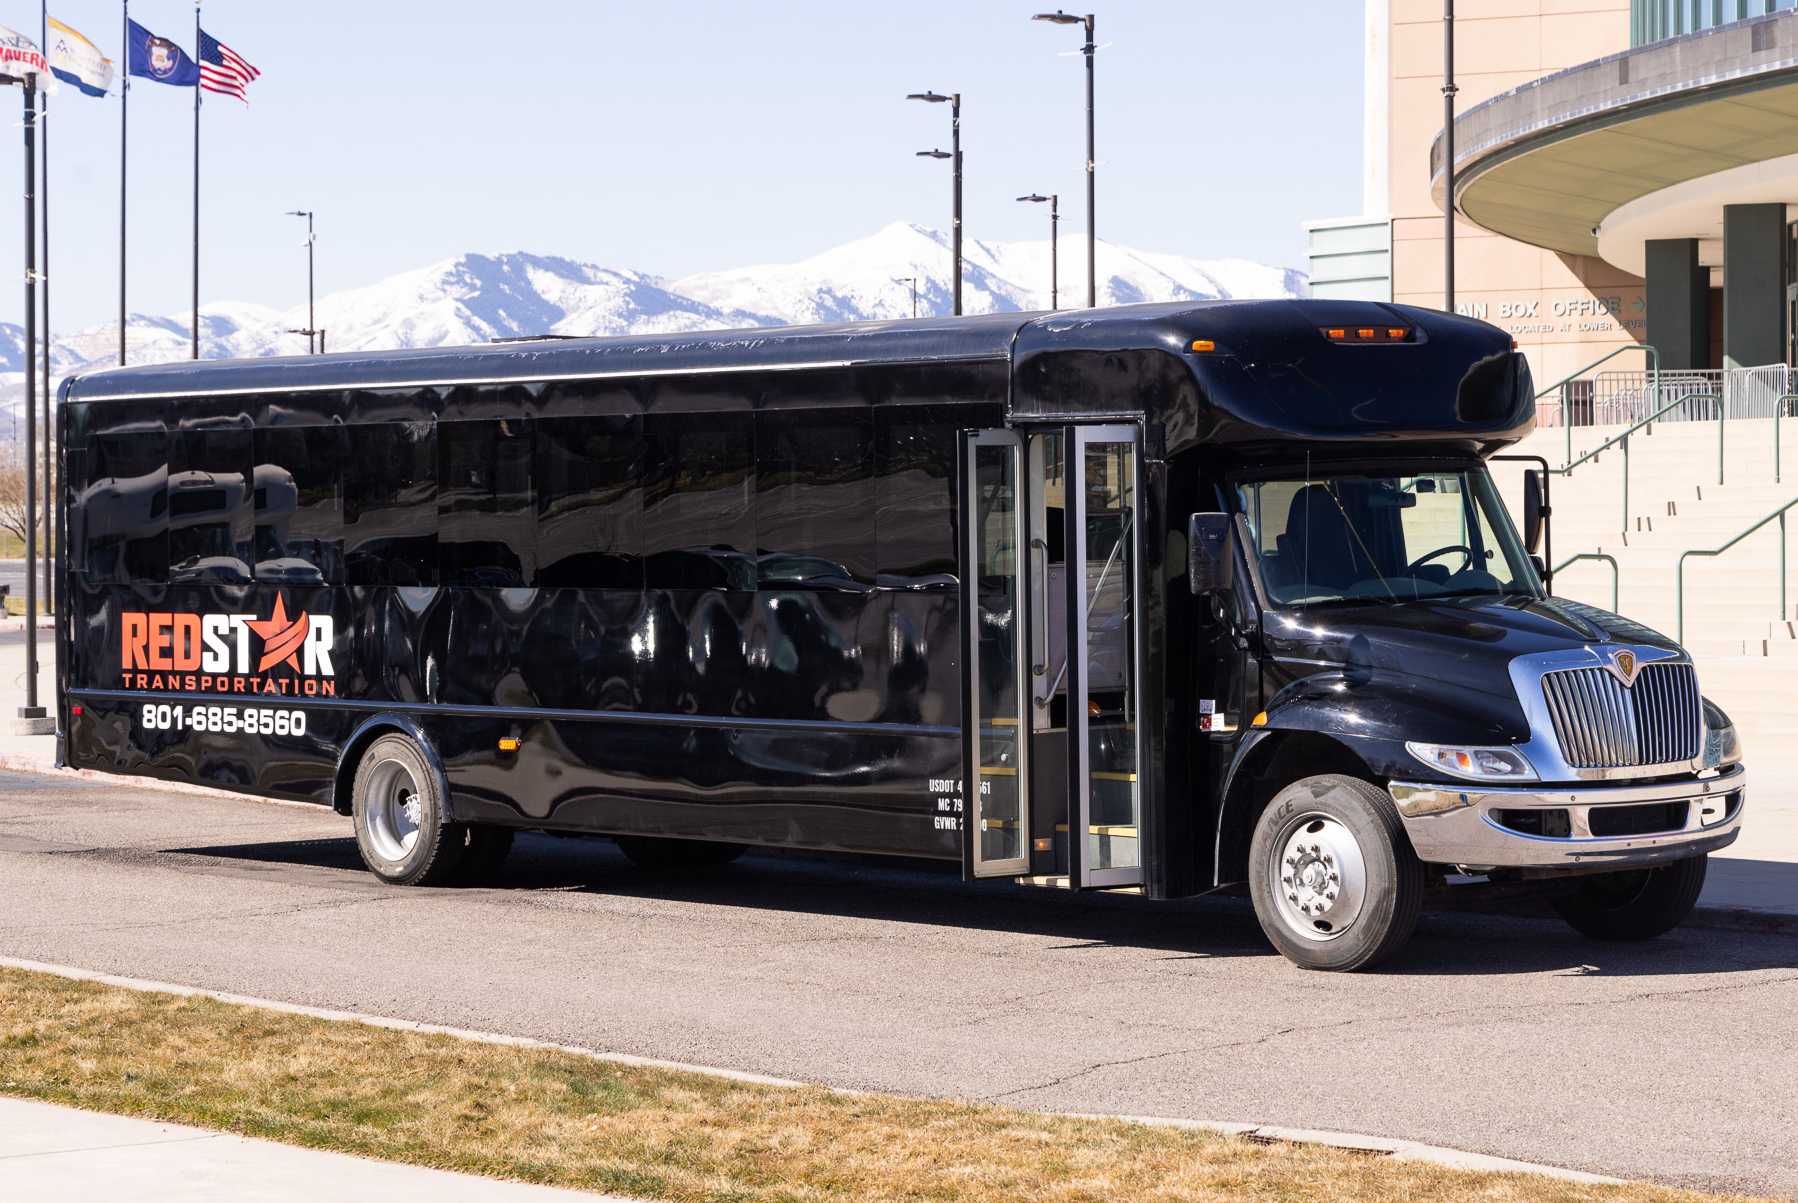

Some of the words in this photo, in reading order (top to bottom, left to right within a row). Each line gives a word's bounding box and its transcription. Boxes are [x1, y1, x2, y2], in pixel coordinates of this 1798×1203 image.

[1499, 301, 1540, 319] BOX
[1553, 297, 1622, 317] OFFICE
[1509, 324, 1554, 334] LOCATED
[1578, 320, 1613, 332] LOWER
[122, 673, 336, 696] TRANSPORTATION
[142, 704, 307, 737] 801-685-8560
[929, 779, 955, 793] USDOT
[938, 797, 951, 812] MC
[934, 816, 957, 830] GVWR
